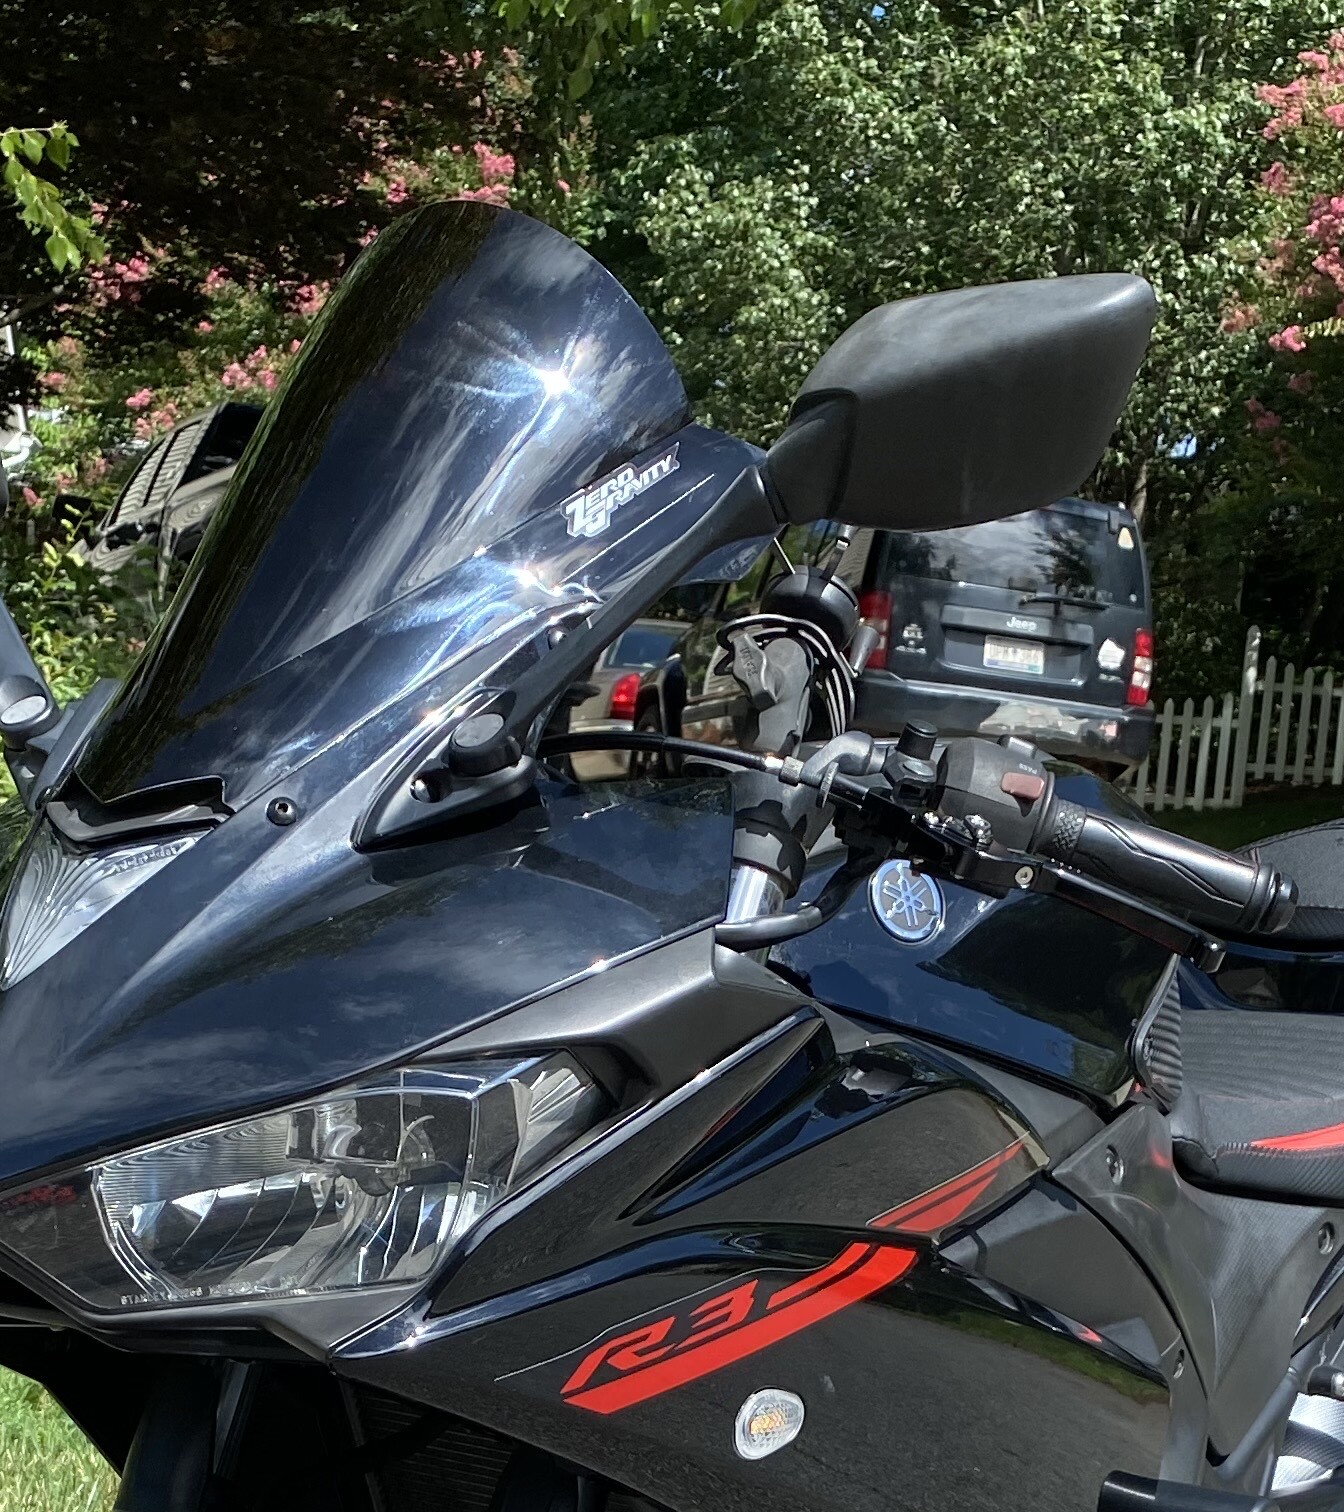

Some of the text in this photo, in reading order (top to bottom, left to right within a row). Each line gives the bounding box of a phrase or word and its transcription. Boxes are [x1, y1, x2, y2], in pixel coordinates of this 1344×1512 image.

[565, 467, 634, 533] ZERO
[584, 454, 672, 534] GRAVITY
[1006, 616, 1037, 632] Jeep
[560, 1279, 759, 1395] R3
